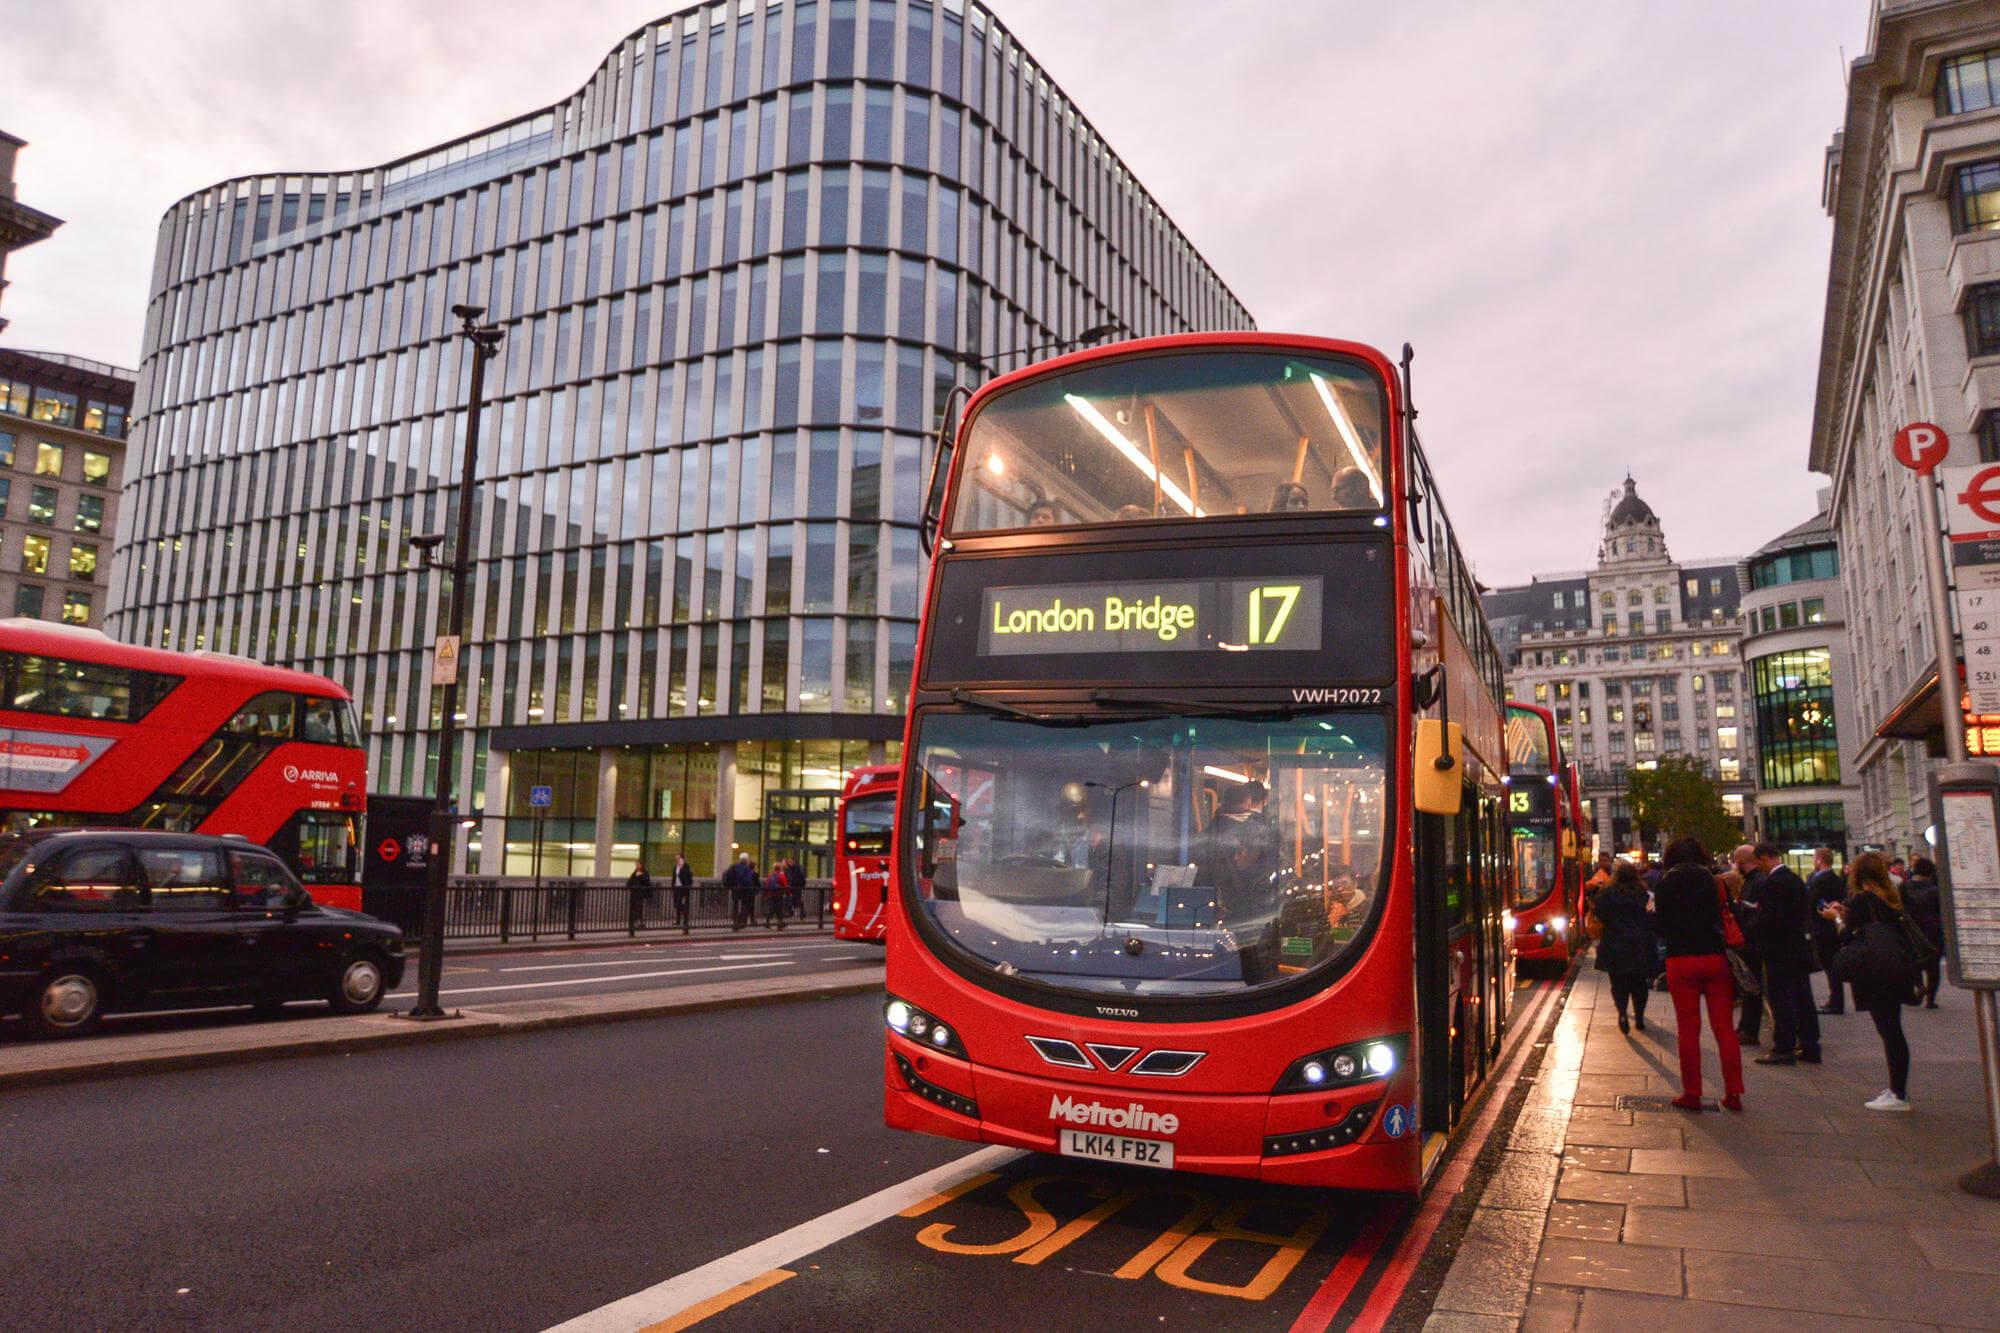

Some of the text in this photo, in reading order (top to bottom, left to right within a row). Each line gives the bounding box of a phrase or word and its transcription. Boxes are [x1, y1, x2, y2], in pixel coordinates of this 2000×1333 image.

[1908, 428, 1935, 461] P
[1968, 597, 1983, 607] 17
[993, 595, 1195, 641] London Bridge
[1248, 585, 1302, 645] 17
[1972, 621, 1988, 631] 40
[1975, 645, 1991, 655] 48
[1975, 671, 1997, 681] 521
[1292, 689, 1382, 704] VWH2022
[300, 769, 338, 782] ARRIVA
[1096, 1006, 1139, 1017] VOLVO
[1049, 1093, 1180, 1134] Metroline
[1072, 1133, 1162, 1163] LK14 FBZ
